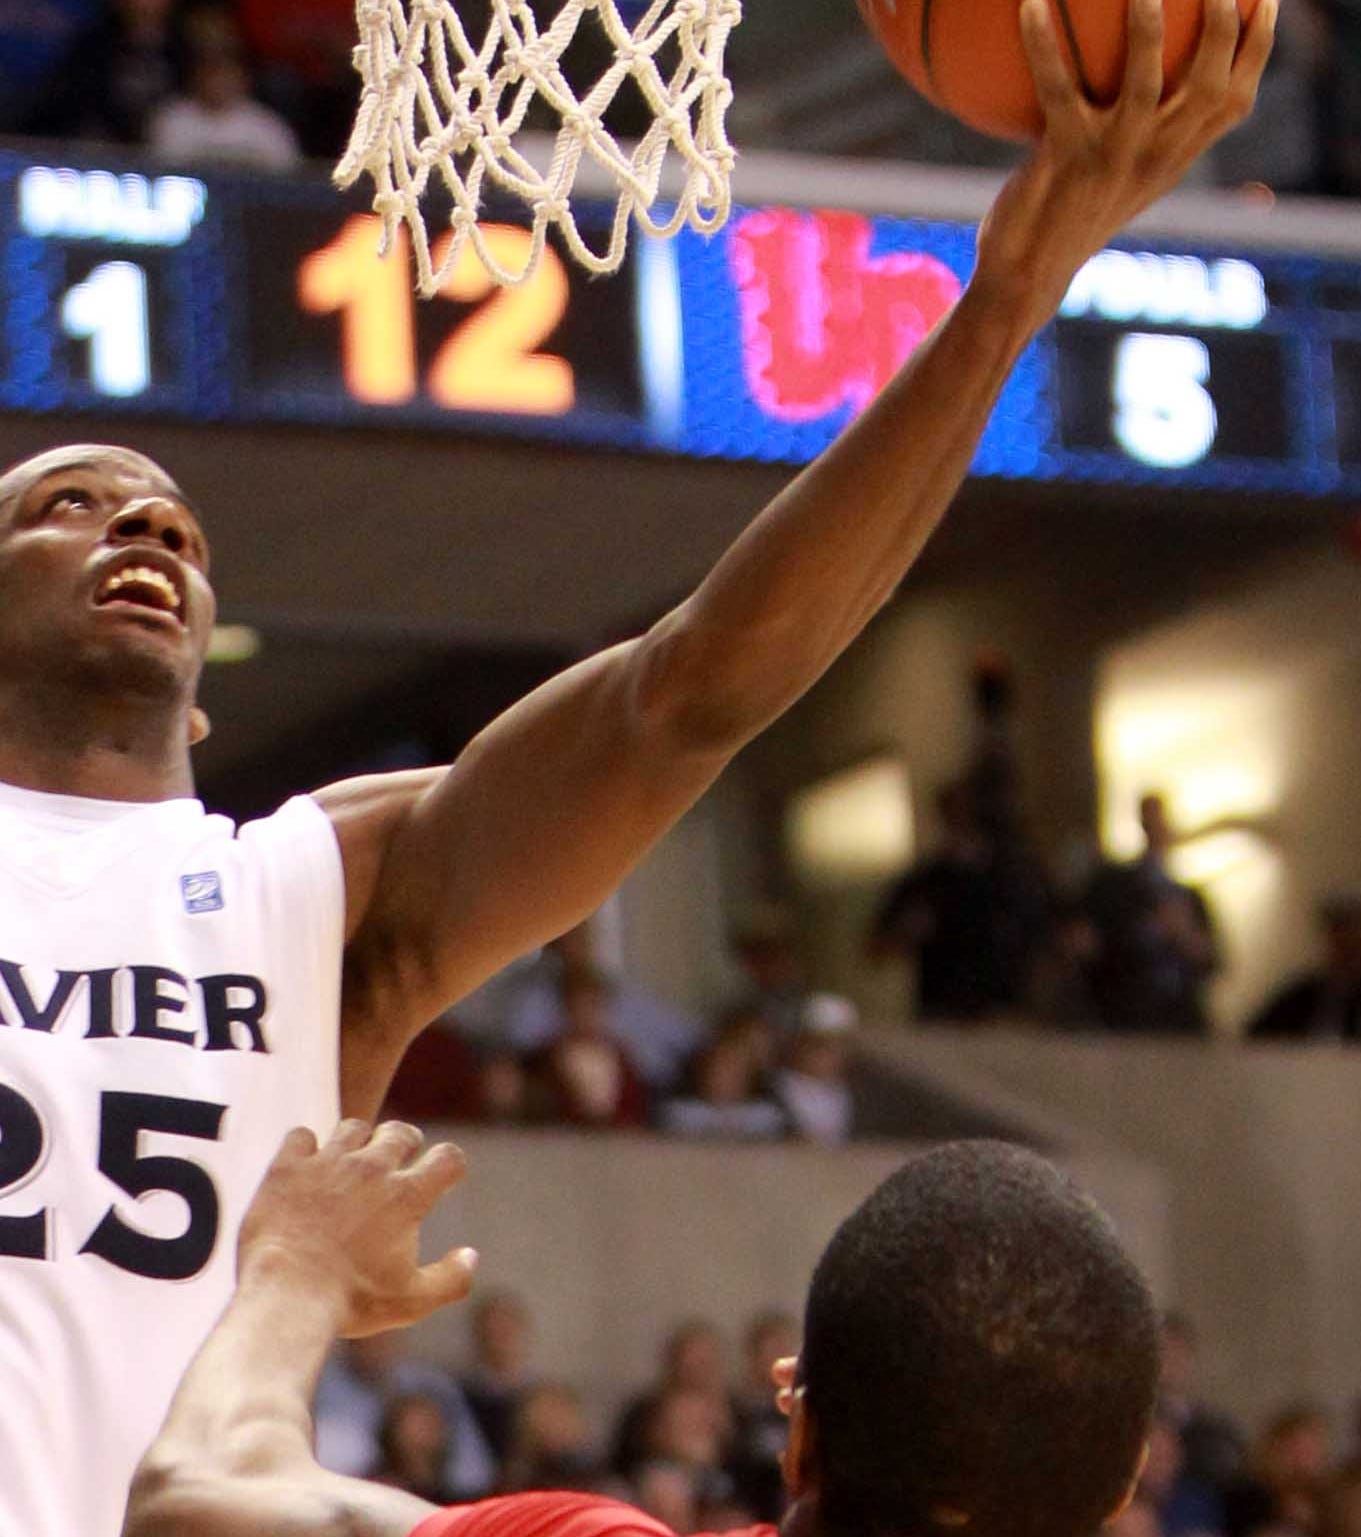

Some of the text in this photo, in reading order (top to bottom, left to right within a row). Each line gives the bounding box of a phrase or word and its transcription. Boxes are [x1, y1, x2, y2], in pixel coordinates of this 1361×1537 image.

[62, 260, 151, 397] 1
[297, 212, 575, 416] 12
[1113, 332, 1218, 468] 5
